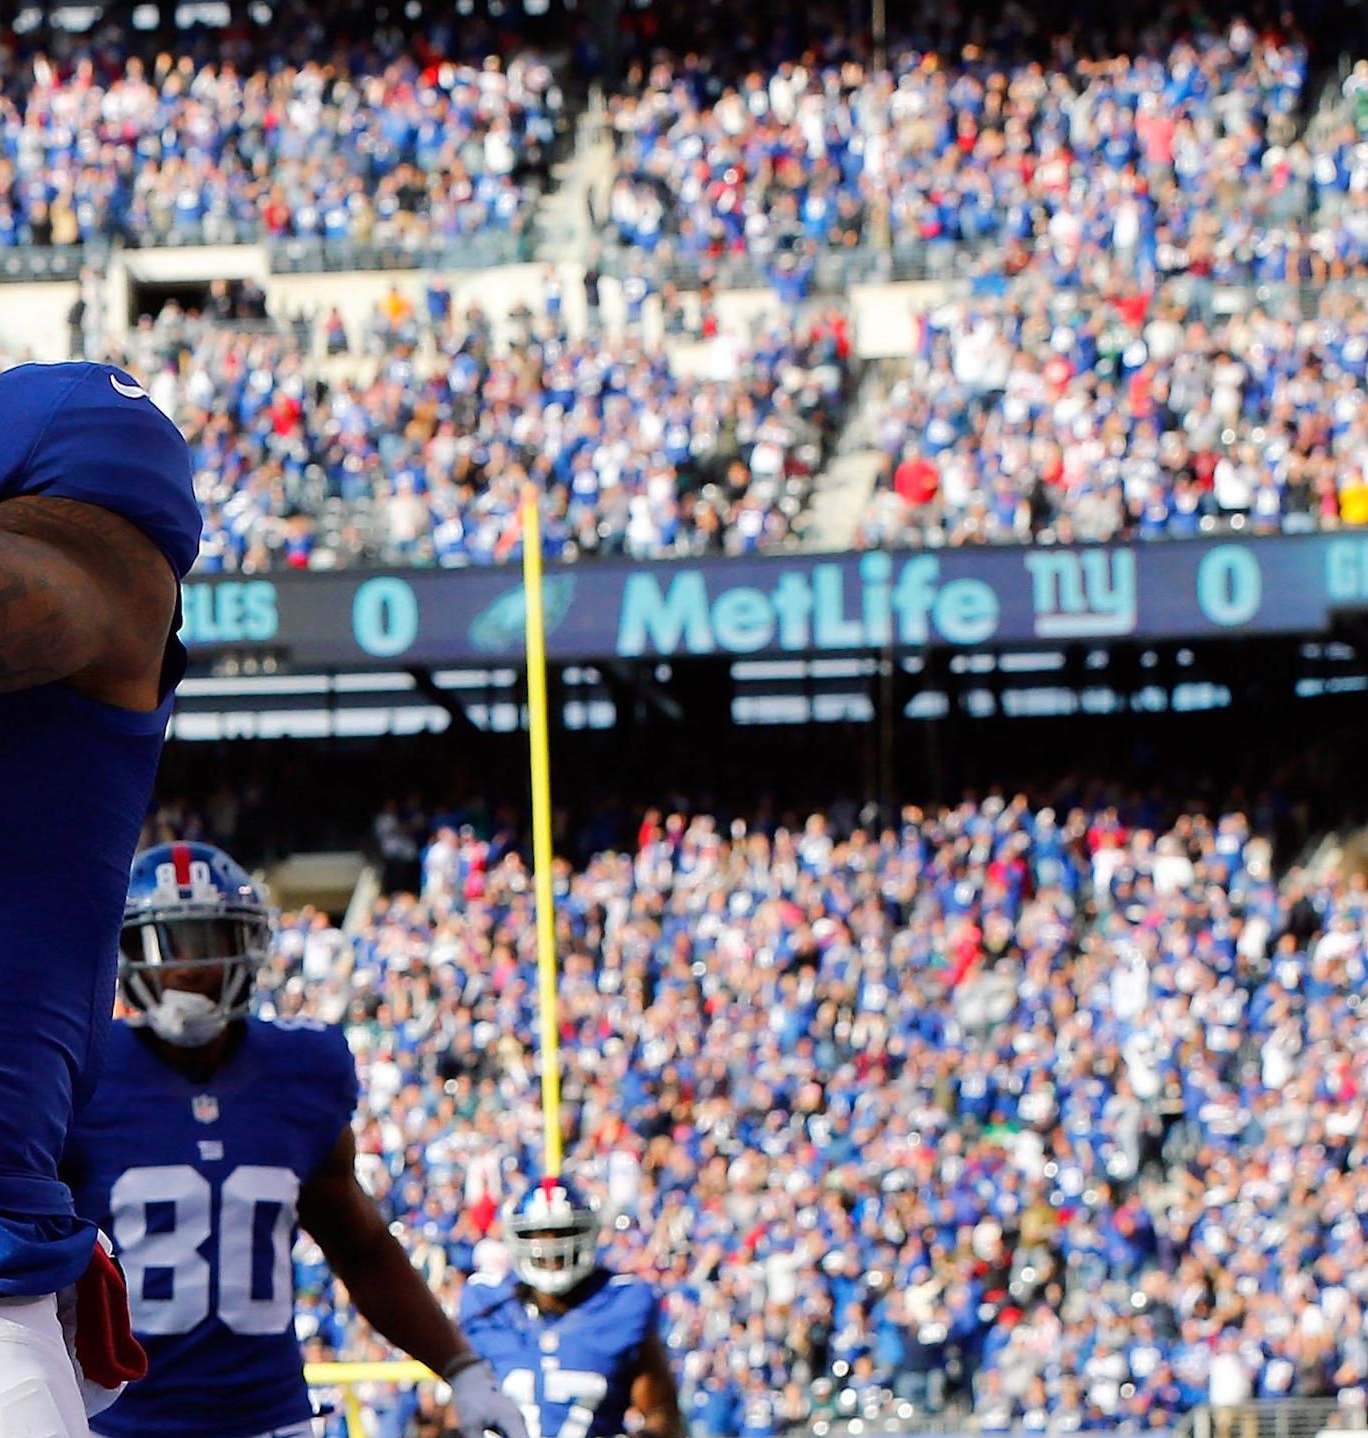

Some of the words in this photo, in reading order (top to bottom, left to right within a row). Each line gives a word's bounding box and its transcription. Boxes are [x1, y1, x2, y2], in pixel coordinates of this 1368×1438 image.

[180, 580, 279, 642] LES
[353, 576, 419, 657] 0
[616, 550, 1000, 656] MetLife
[1196, 544, 1262, 627] 0
[111, 1165, 301, 1336] 80
